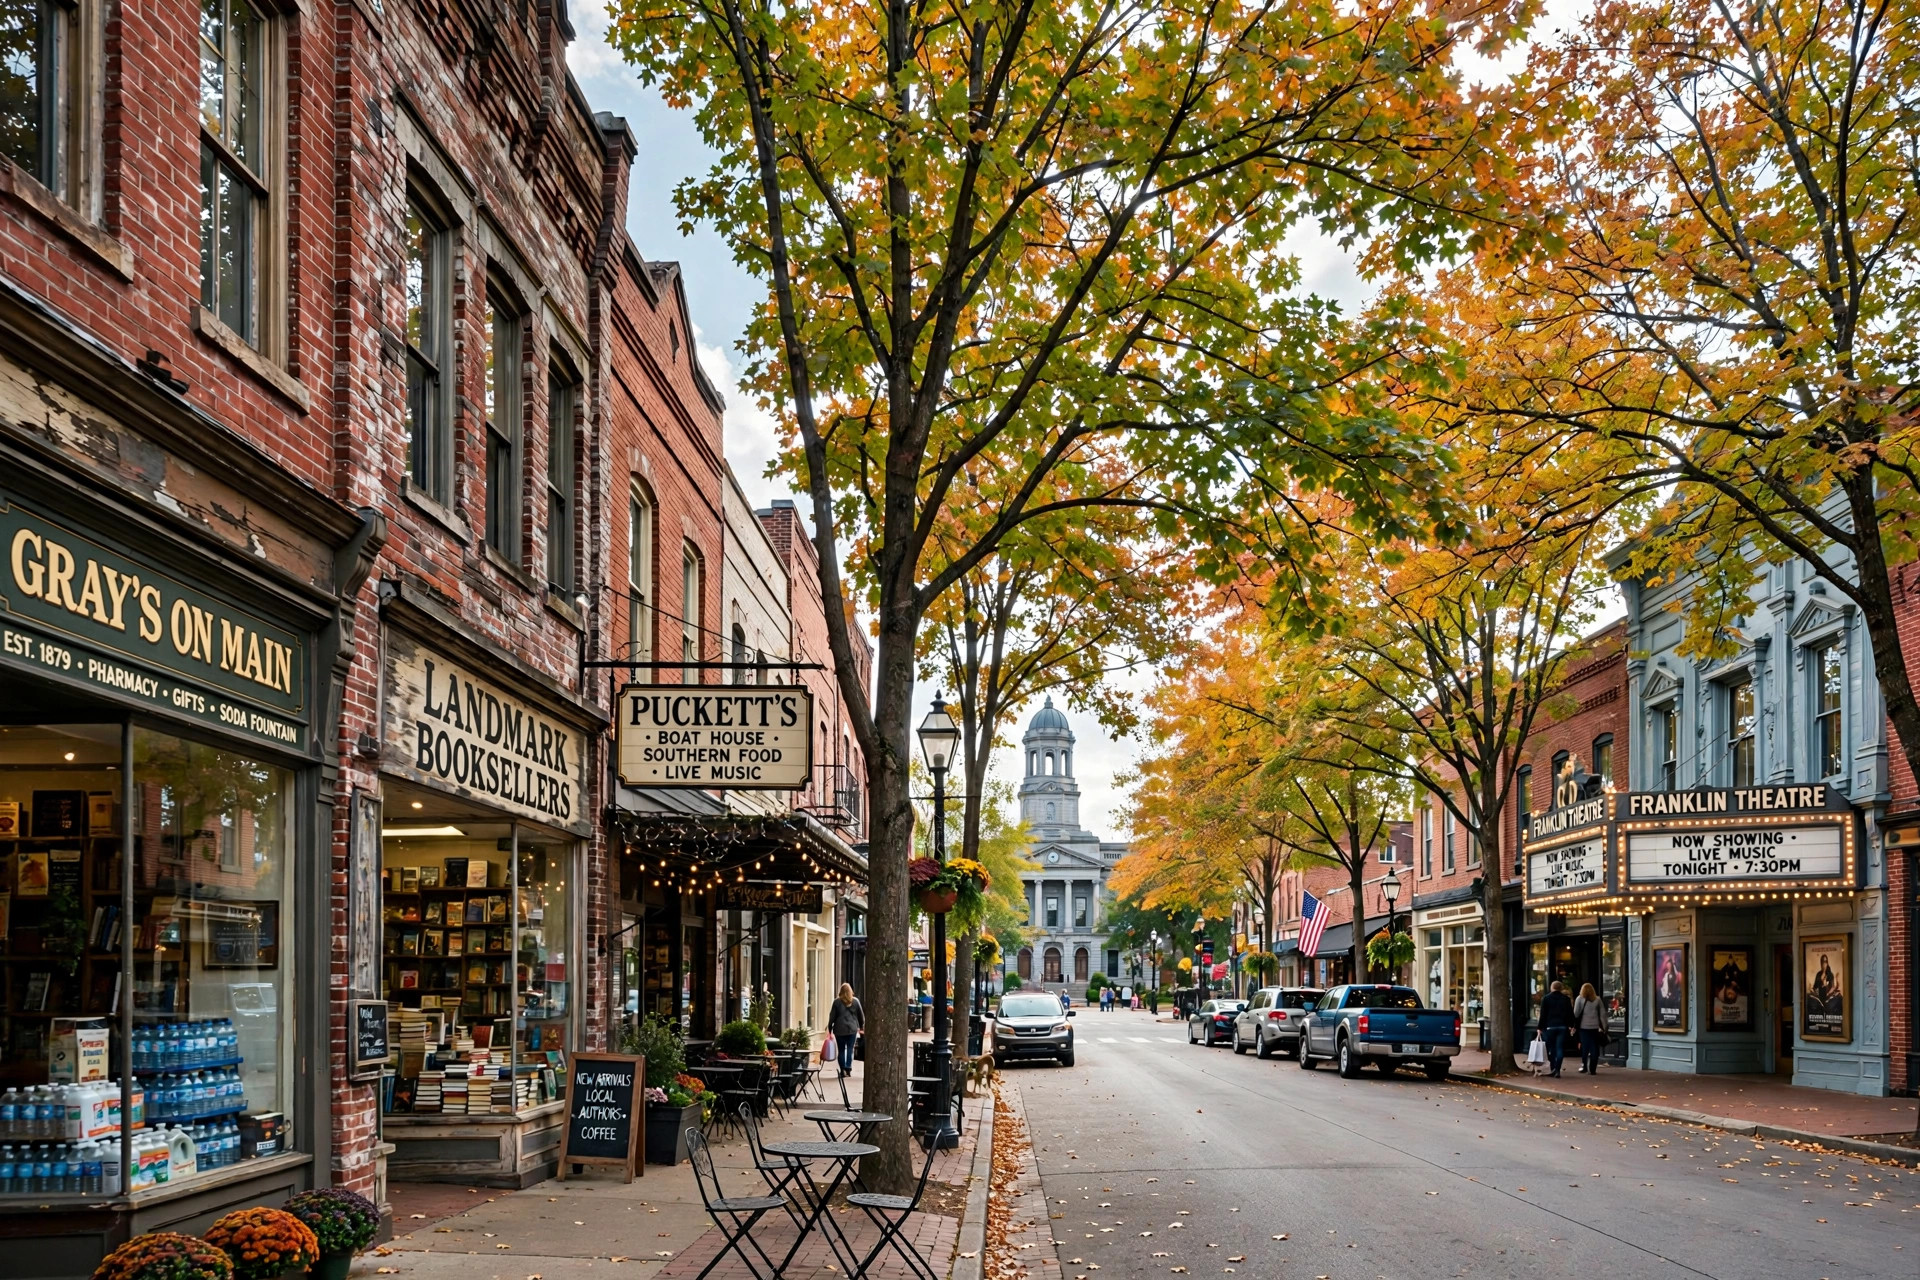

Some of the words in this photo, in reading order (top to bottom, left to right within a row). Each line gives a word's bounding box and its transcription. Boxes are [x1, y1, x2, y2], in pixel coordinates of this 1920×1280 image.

[10, 528, 163, 643] GRAY'S
[170, 598, 214, 665] ON
[219, 617, 293, 695] MAIN
[4, 630, 35, 659] EST.
[39, 642, 71, 670] 1879
[88, 658, 159, 698] PHARMACY
[172, 688, 205, 714] GIFTS
[219, 703, 248, 729] SODA
[250, 716, 297, 744] FOUNTAIN
[423, 658, 568, 776] LANDMARK
[629, 693, 798, 728] PUCKETT'S
[658, 731, 701, 745] BOAT
[710, 731, 765, 745] HOUSE
[643, 748, 730, 763] SOUTHERN
[738, 749, 783, 763] FOOD
[416, 719, 571, 820] BOOKSELLERS
[665, 766, 701, 780] LIVE
[710, 766, 762, 780] MUSIC
[1629, 791, 1727, 816] FRANKLIN
[1734, 786, 1826, 811] THEATRE
[1672, 835, 1705, 848] NOW
[1713, 832, 1784, 846] SHOWING
[1689, 848, 1721, 861] LIVE
[1729, 846, 1776, 859] MUSIC
[1664, 861, 1727, 876] TONIGHT
[1745, 859, 1801, 874] 7:30PM
[576, 1072, 595, 1085] NEW
[585, 1088, 616, 1103] LOCAL
[581, 1126, 617, 1141] COFFEE
